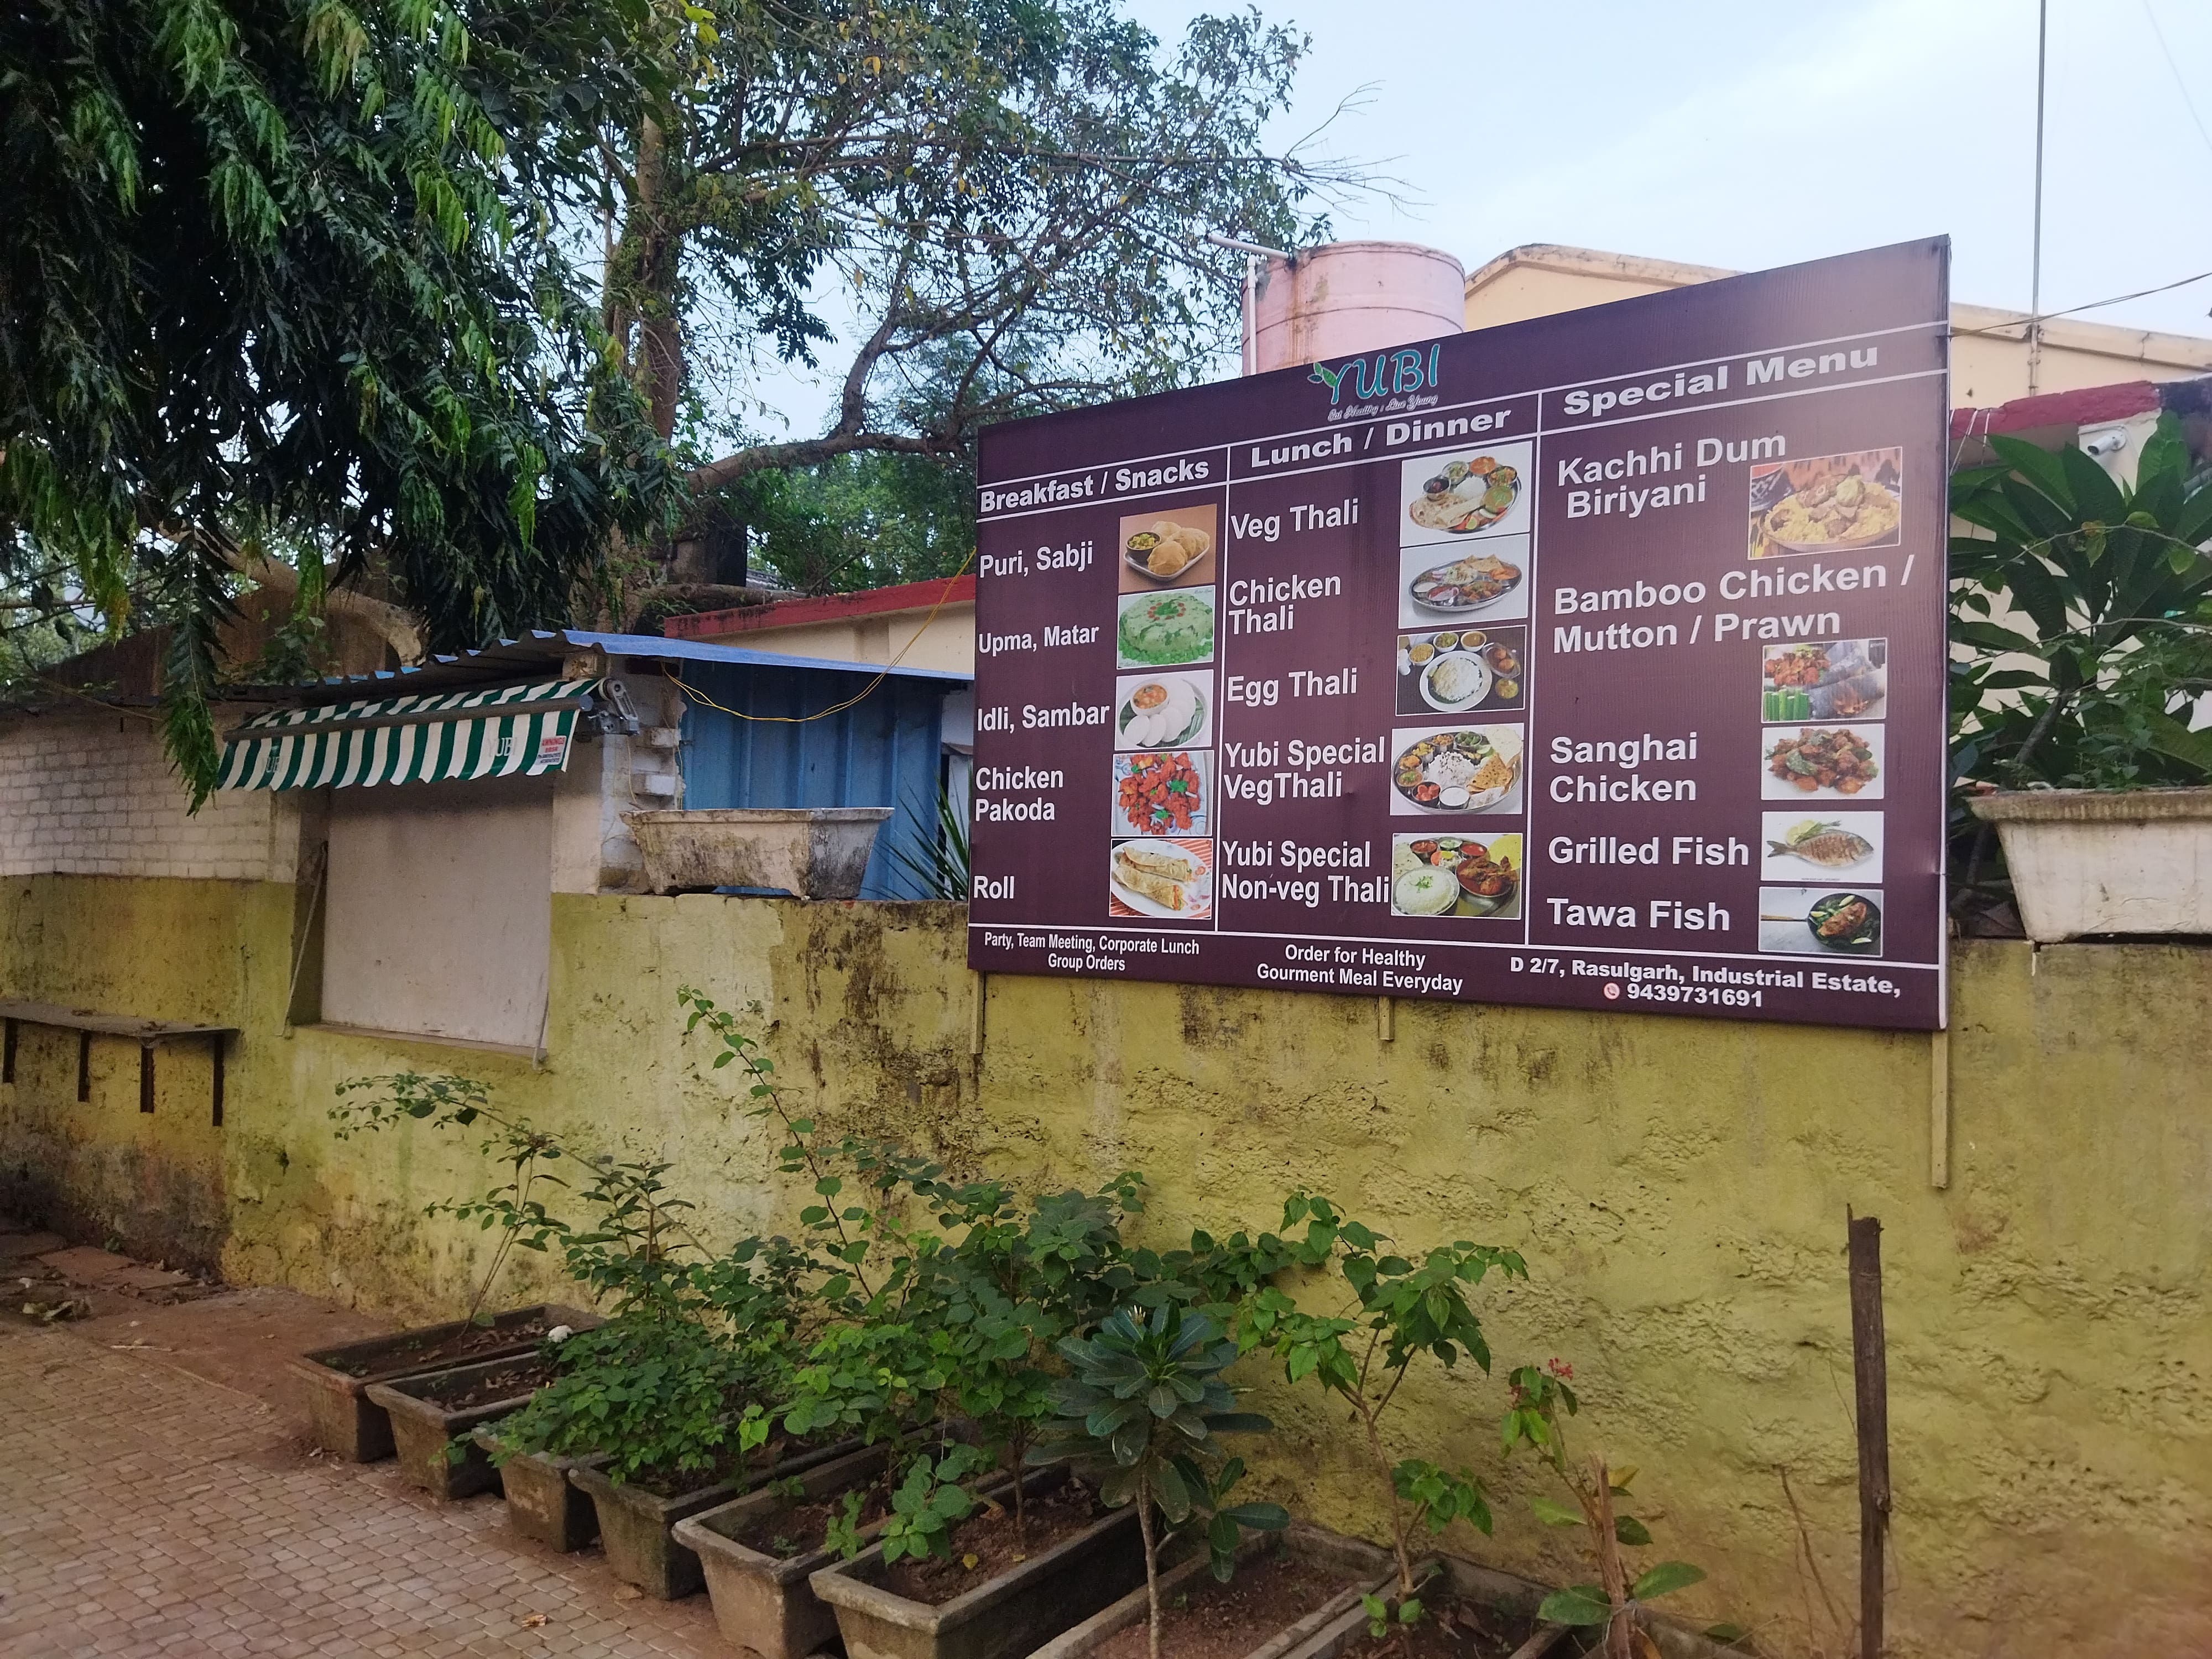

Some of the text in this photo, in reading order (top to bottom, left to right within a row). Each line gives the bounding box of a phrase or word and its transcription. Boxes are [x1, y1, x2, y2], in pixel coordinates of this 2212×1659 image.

[1307, 343, 1440, 405] YUBI
[1563, 347, 1877, 417] Special Menu
[1251, 410, 1512, 468] Lunch / Dinner
[1558, 435, 1786, 487] Kachhi Dum
[980, 459, 1209, 513] Breakfast / Snacks
[1567, 474, 1706, 519] Biriyani
[1230, 498, 1358, 542] Veg Thali
[980, 540, 1093, 578] Puri, Sabji
[1229, 574, 1340, 606] Chicken
[1554, 554, 1915, 615] Bamboo Chicken /
[1228, 604, 1293, 635] Thali
[1554, 612, 1840, 654] Mutton / Prawn
[979, 624, 1099, 657] Upma, Matar
[1227, 667, 1357, 707] Egg Thali
[978, 702, 1110, 734] Idli, Sambar
[1224, 736, 1385, 772] Yubi Special
[1550, 732, 1697, 769] Sanghai
[976, 765, 1063, 791] Chicken
[1550, 774, 1696, 803] Chicken
[975, 797, 1055, 822] Pakoda
[1222, 840, 1370, 873] Yubi Special
[1548, 836, 1749, 865] Grilled Fish
[973, 875, 1015, 899] Roll
[1222, 873, 1390, 907] Non-veg Thali
[1546, 898, 1730, 931] Tawa Fish
[984, 931, 1199, 955] Party, Team Meeting, Corporate Lunch
[1285, 944, 1426, 971] Order for Healthy
[1048, 953, 1125, 972] Group Orders
[1257, 963, 1463, 995] Gourment Meal Everyday
[1510, 957, 1901, 998] D 2/7, Rasulgarh, Industrial Estate,
[1627, 983, 1762, 1007] 9439731691
